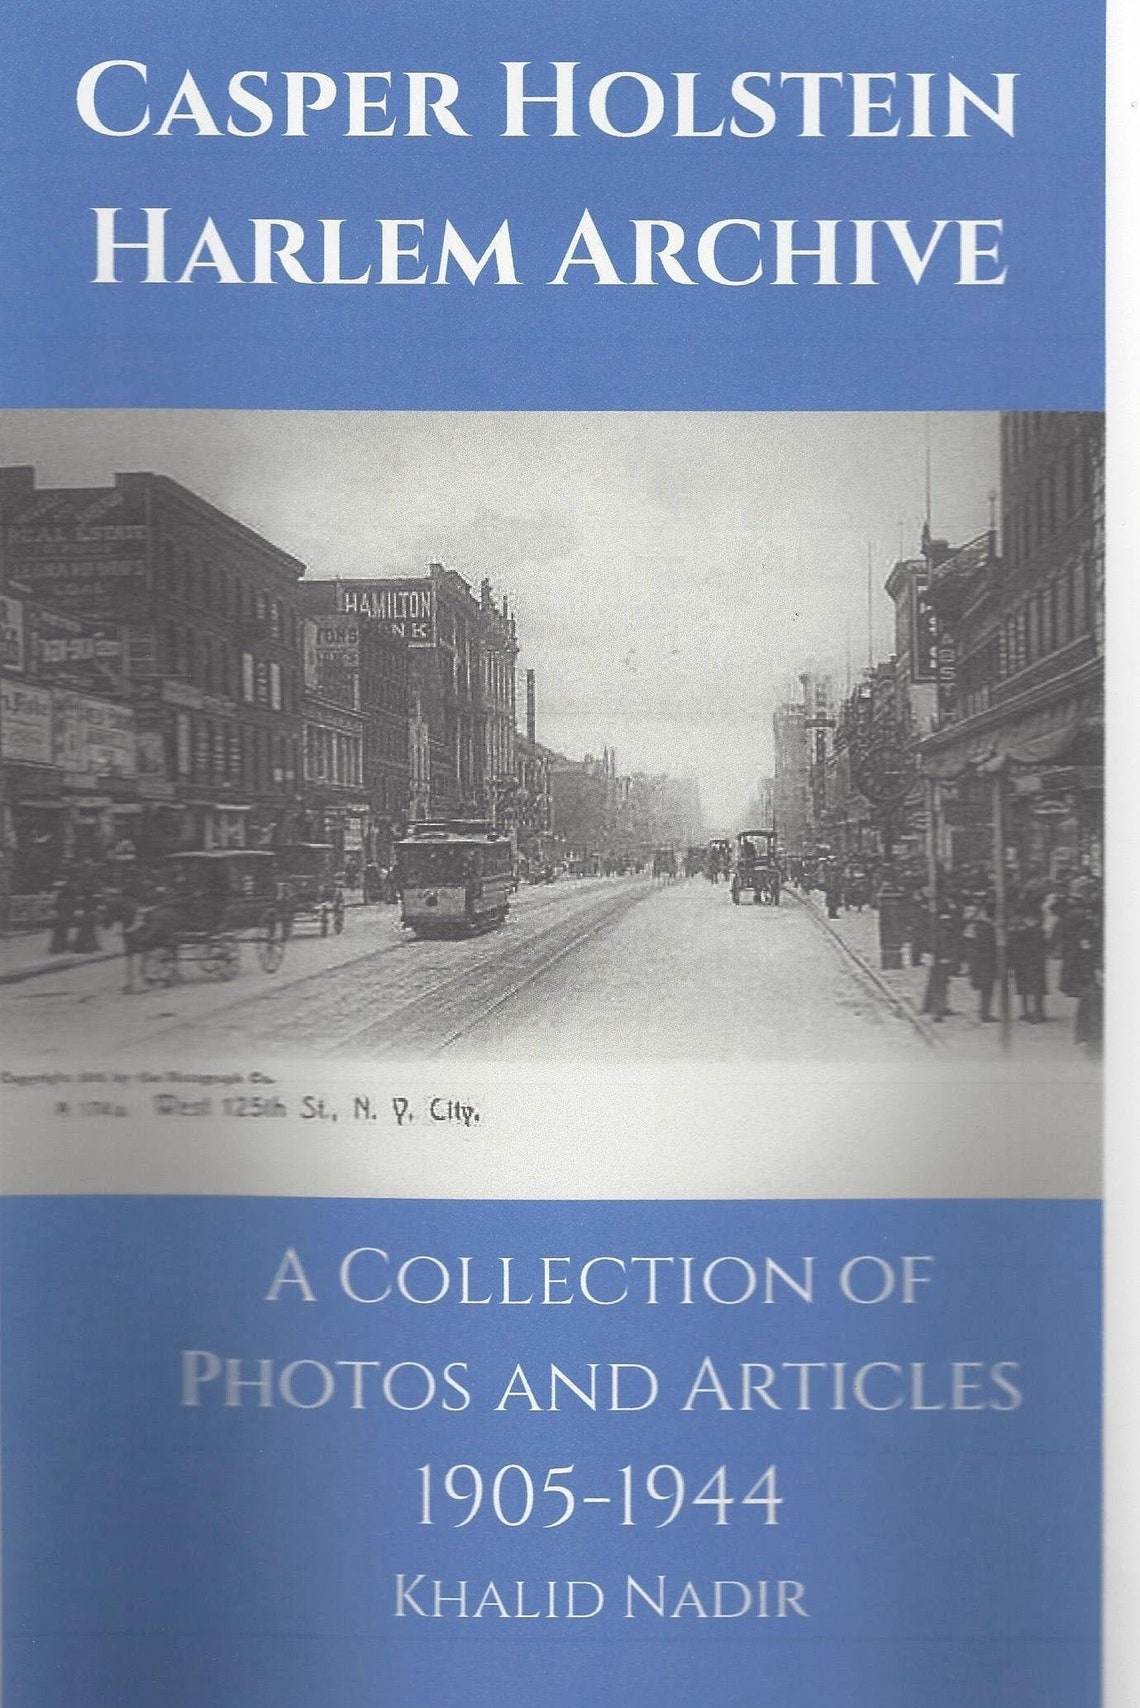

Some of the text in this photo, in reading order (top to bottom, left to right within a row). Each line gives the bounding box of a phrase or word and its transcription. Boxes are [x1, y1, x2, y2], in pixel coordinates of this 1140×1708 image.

[76, 59, 1017, 139] CASPER HOLSTEIN
[92, 206, 1009, 287] HARLEM ARCHIVE
[345, 591, 431, 619] HAMILTON
[353, 1096, 377, 1121] N.
[265, 1246, 936, 1307] A COLLECTION OF
[178, 1349, 1023, 1414] PHOTOS AND ARTICLES
[393, 1572, 811, 1620] KHALID NADIR
